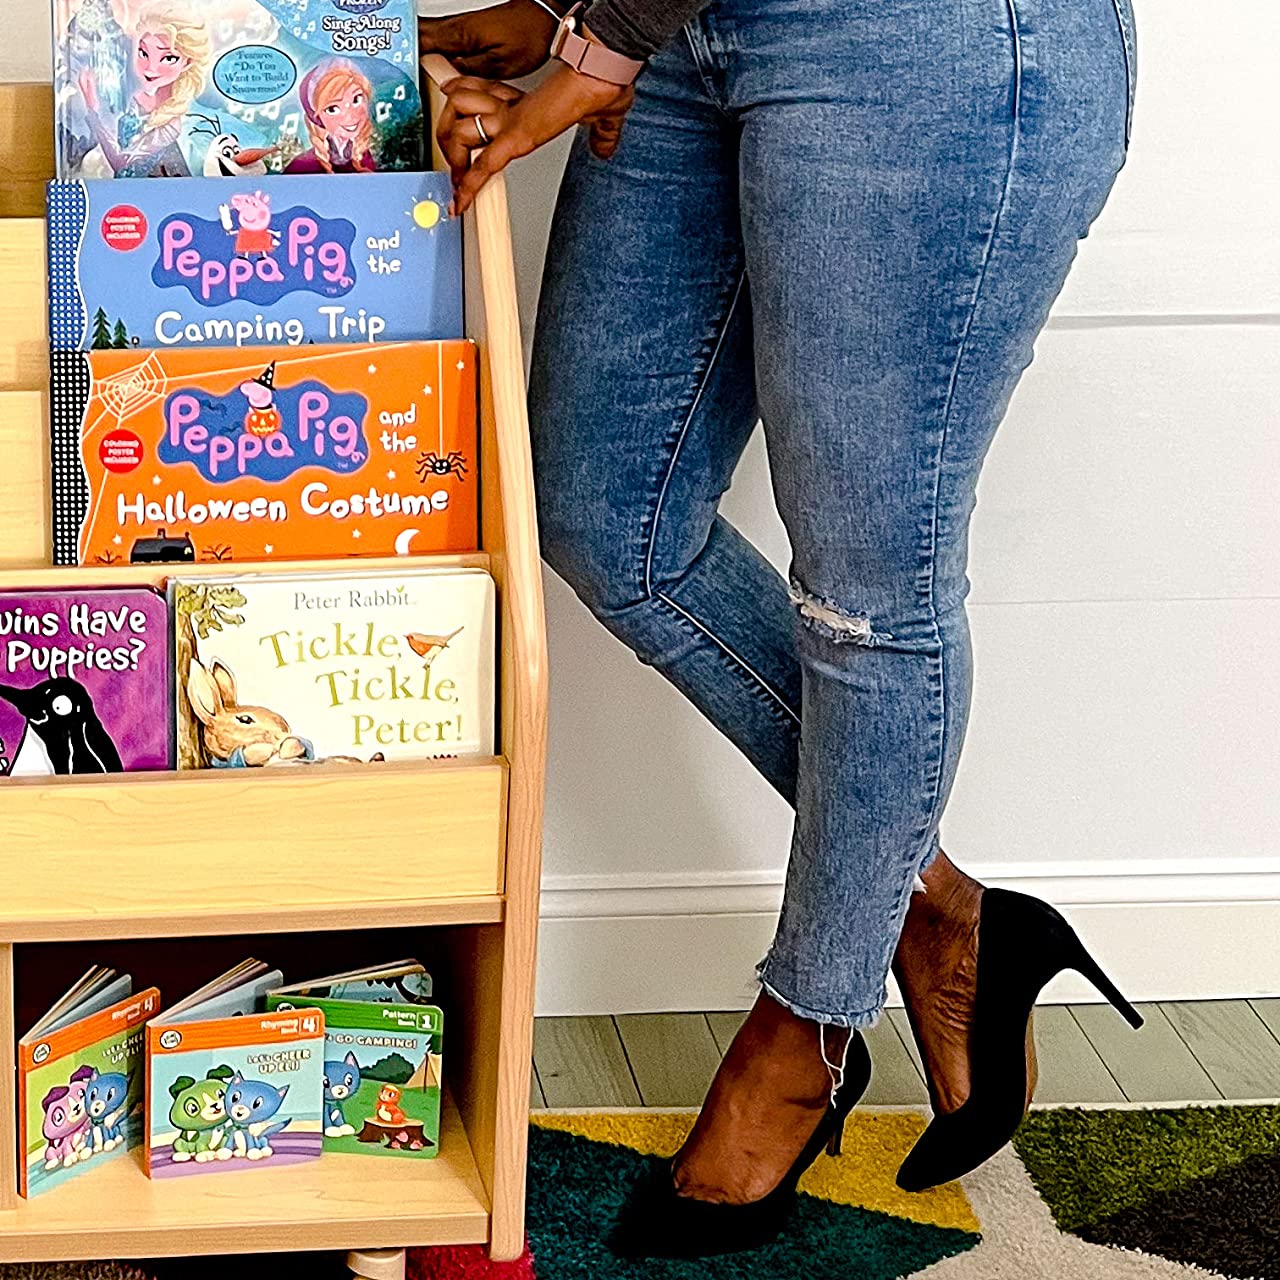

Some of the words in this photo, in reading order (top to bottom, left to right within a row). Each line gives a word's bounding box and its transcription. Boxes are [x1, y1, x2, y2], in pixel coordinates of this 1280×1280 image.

[322, 15, 401, 34] Sing-Along
[332, 30, 391, 55] Songs!
[366, 230, 400, 250] and
[163, 220, 284, 298] Peppa
[289, 218, 354, 288] Pig
[366, 254, 401, 274] the
[155, 311, 304, 345] Camping
[318, 307, 386, 343] Trip
[379, 403, 416, 425] and
[169, 395, 294, 477] Peppa
[299, 390, 365, 462] Pig
[379, 430, 417, 451] the
[118, 490, 287, 525] Halloween
[300, 483, 448, 519] Costume
[294, 592, 341, 610] Peter
[349, 587, 409, 608] Rabbit
[70, 603, 146, 637] Have
[259, 623, 402, 668] Tickle,
[7, 638, 146, 678] Puppies?
[315, 666, 459, 707] Tickle,
[352, 715, 462, 746] Peter!
[303, 1017, 315, 1032] 4
[383, 1009, 416, 1020] Pattern
[421, 1015, 432, 1029] 1
[336, 1034, 353, 1043] GO
[356, 1036, 417, 1048] CAMPING!
[272, 1049, 311, 1062] CHEER
